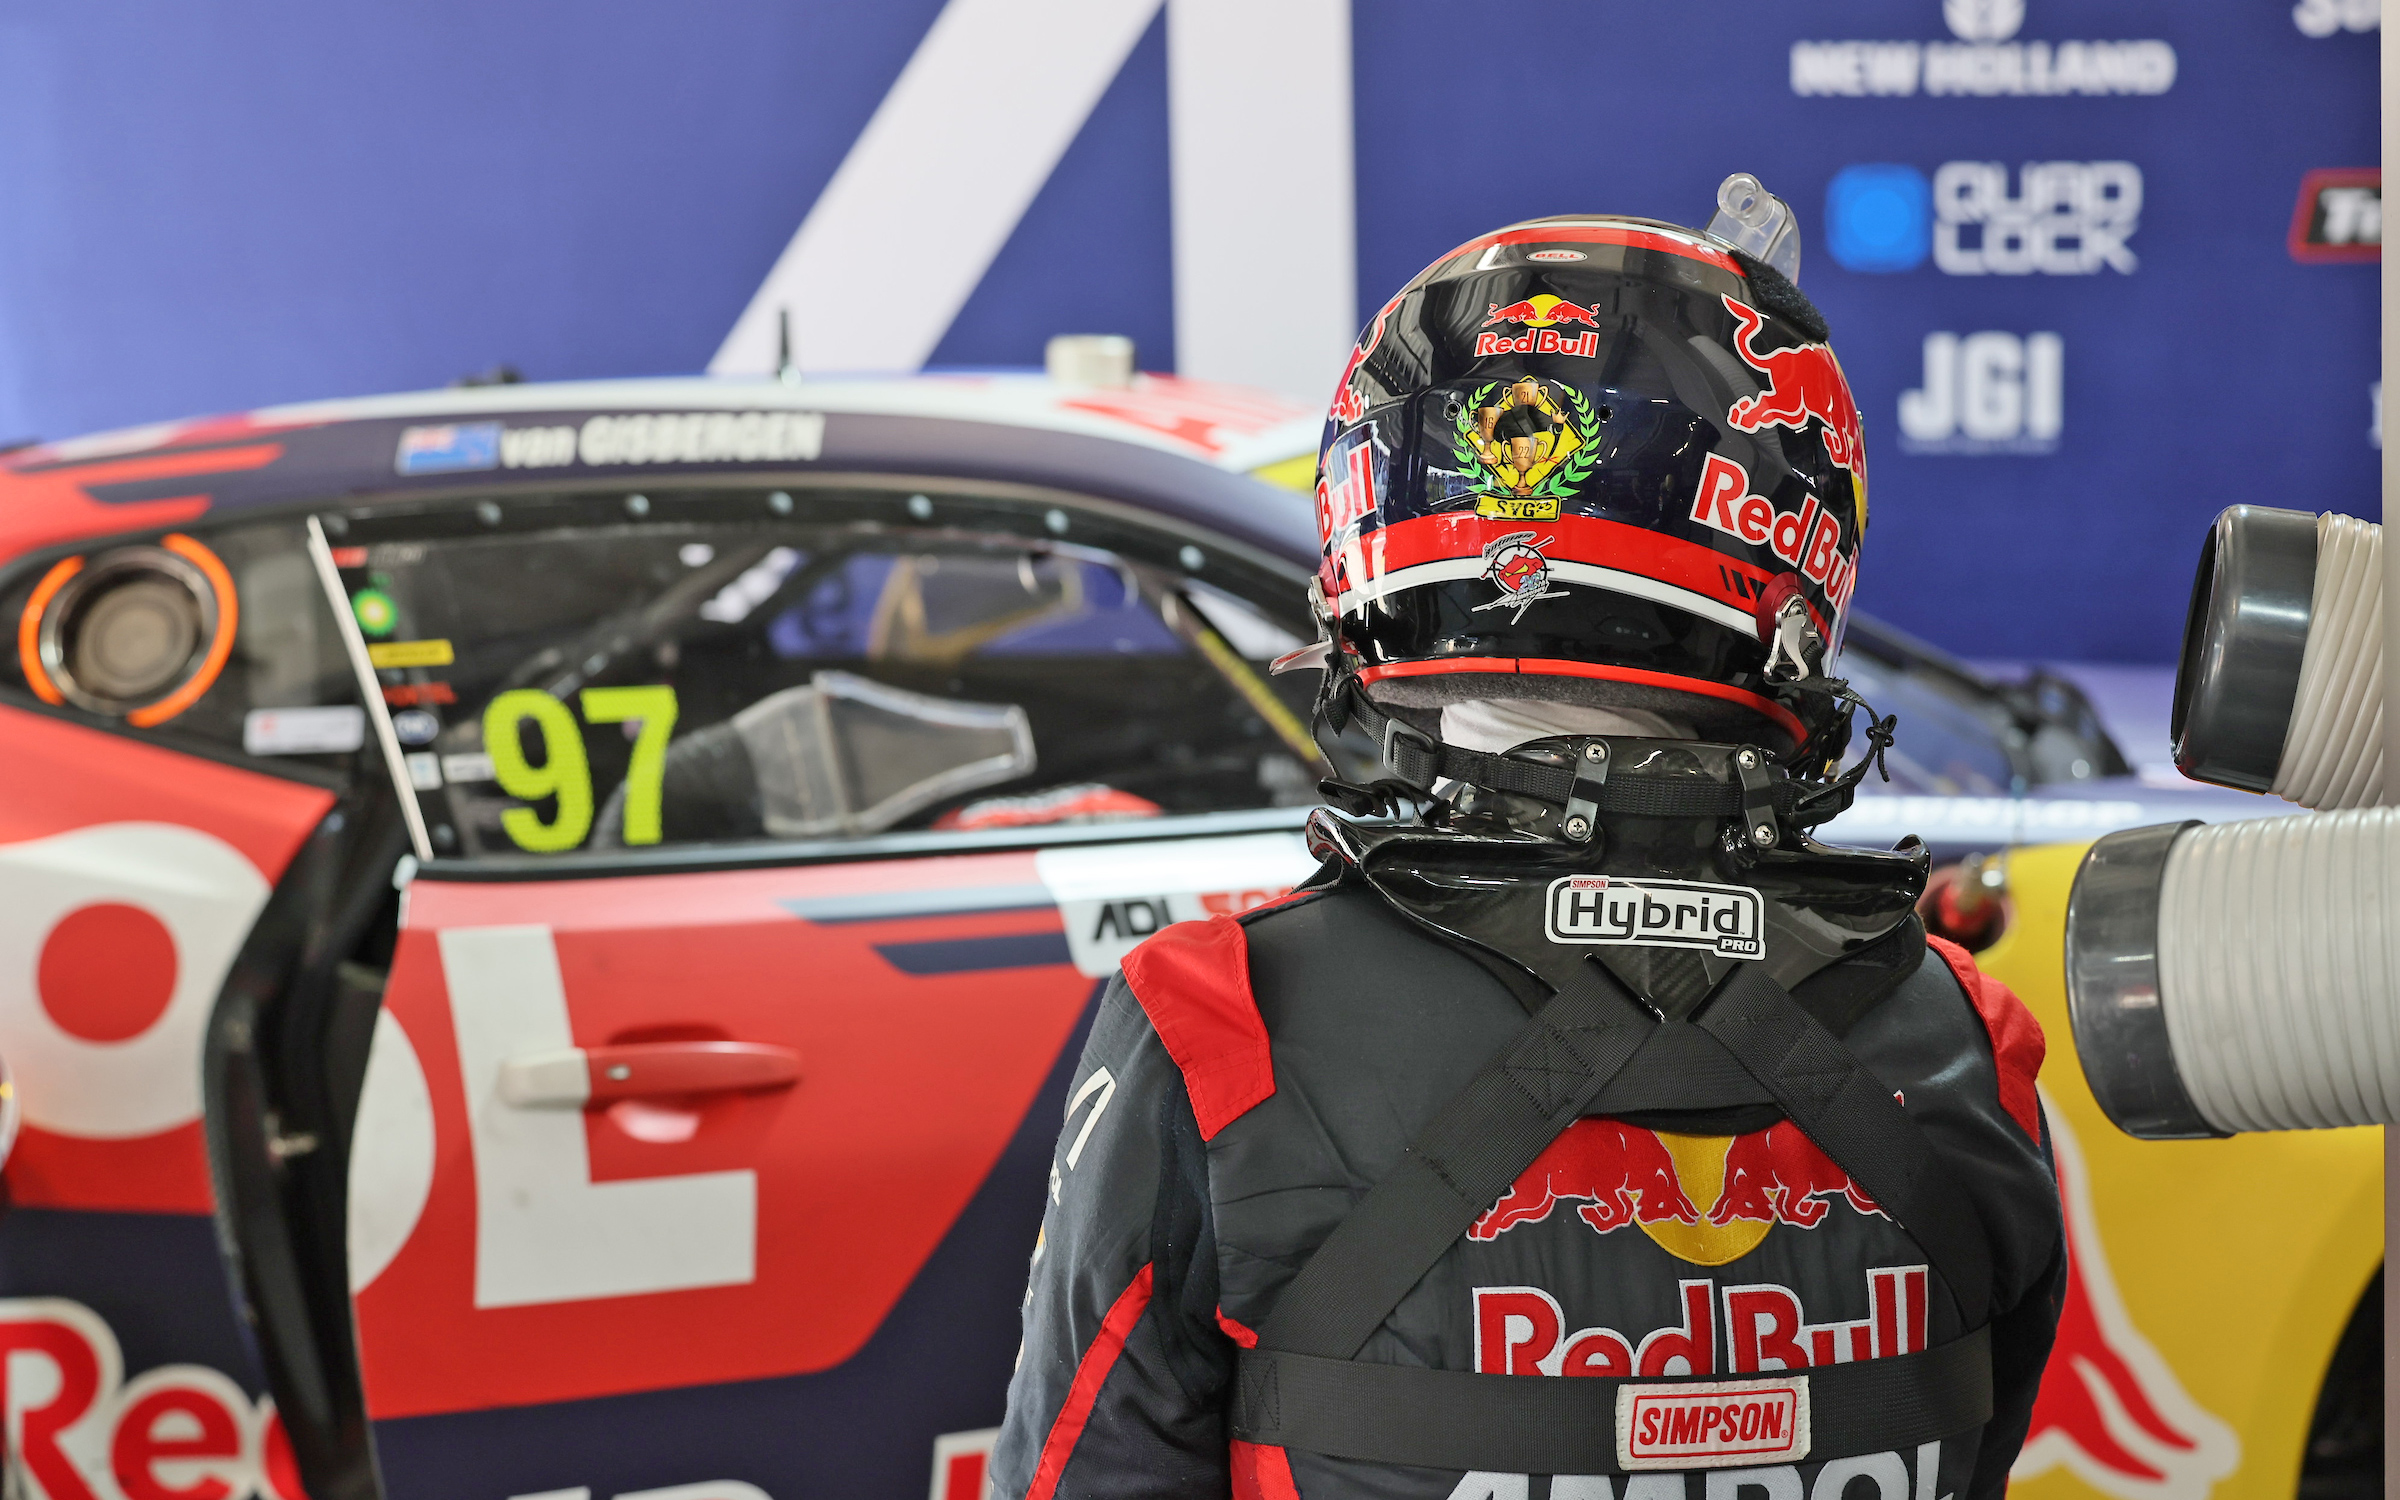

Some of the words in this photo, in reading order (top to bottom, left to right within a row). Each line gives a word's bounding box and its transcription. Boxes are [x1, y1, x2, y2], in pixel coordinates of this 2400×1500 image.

[1791, 41, 1921, 97] NEW
[1923, 41, 2177, 97] HOLLAND
[1933, 160, 2143, 220] QUAD
[1933, 217, 2139, 275] LOCK
[1474, 328, 1537, 357] Red
[1536, 329, 1599, 358] Bull
[1897, 330, 2065, 441] JGI
[1689, 451, 1820, 568] Red
[481, 684, 679, 853] 97
[1572, 879, 1607, 889] SIMPSON
[1569, 891, 1741, 940] Hybrid
[1720, 938, 1757, 952] PRO
[1472, 1278, 1714, 1377] Red
[1639, 1401, 1785, 1446] SIMPSON
